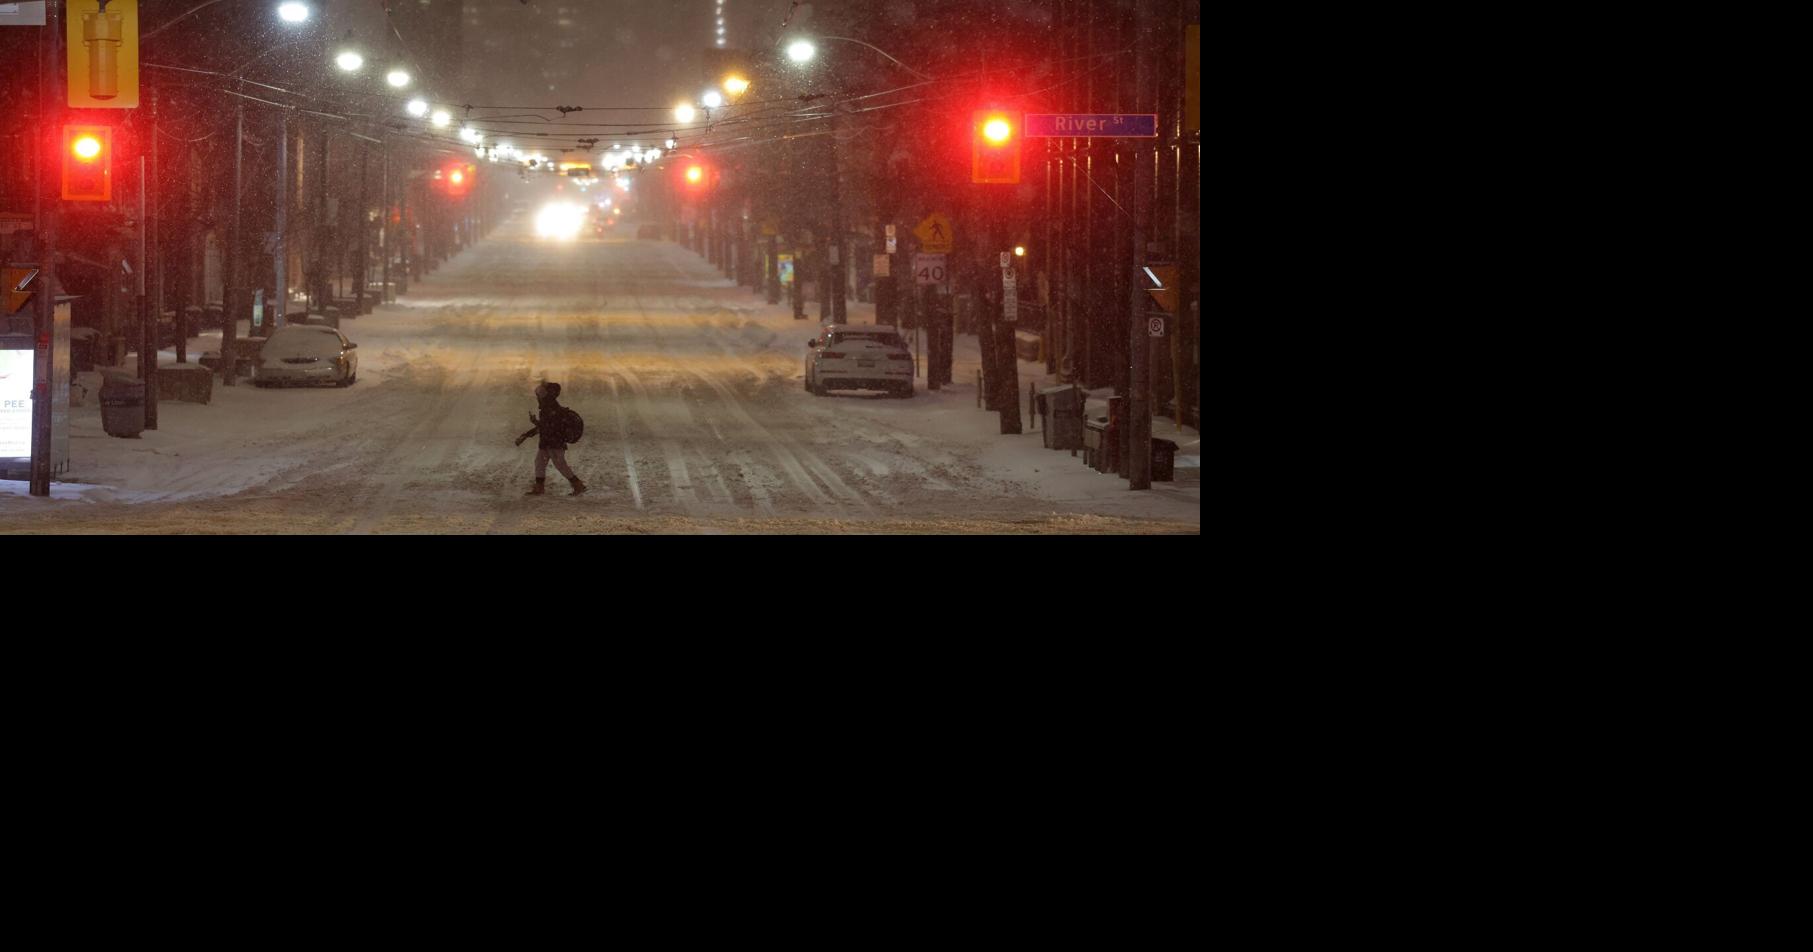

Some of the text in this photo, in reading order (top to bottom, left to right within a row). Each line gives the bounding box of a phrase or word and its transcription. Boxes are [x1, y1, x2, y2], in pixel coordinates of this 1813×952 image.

[1055, 116, 1124, 131] River St
[918, 266, 944, 281] 40
[4, 400, 25, 408] PEE
